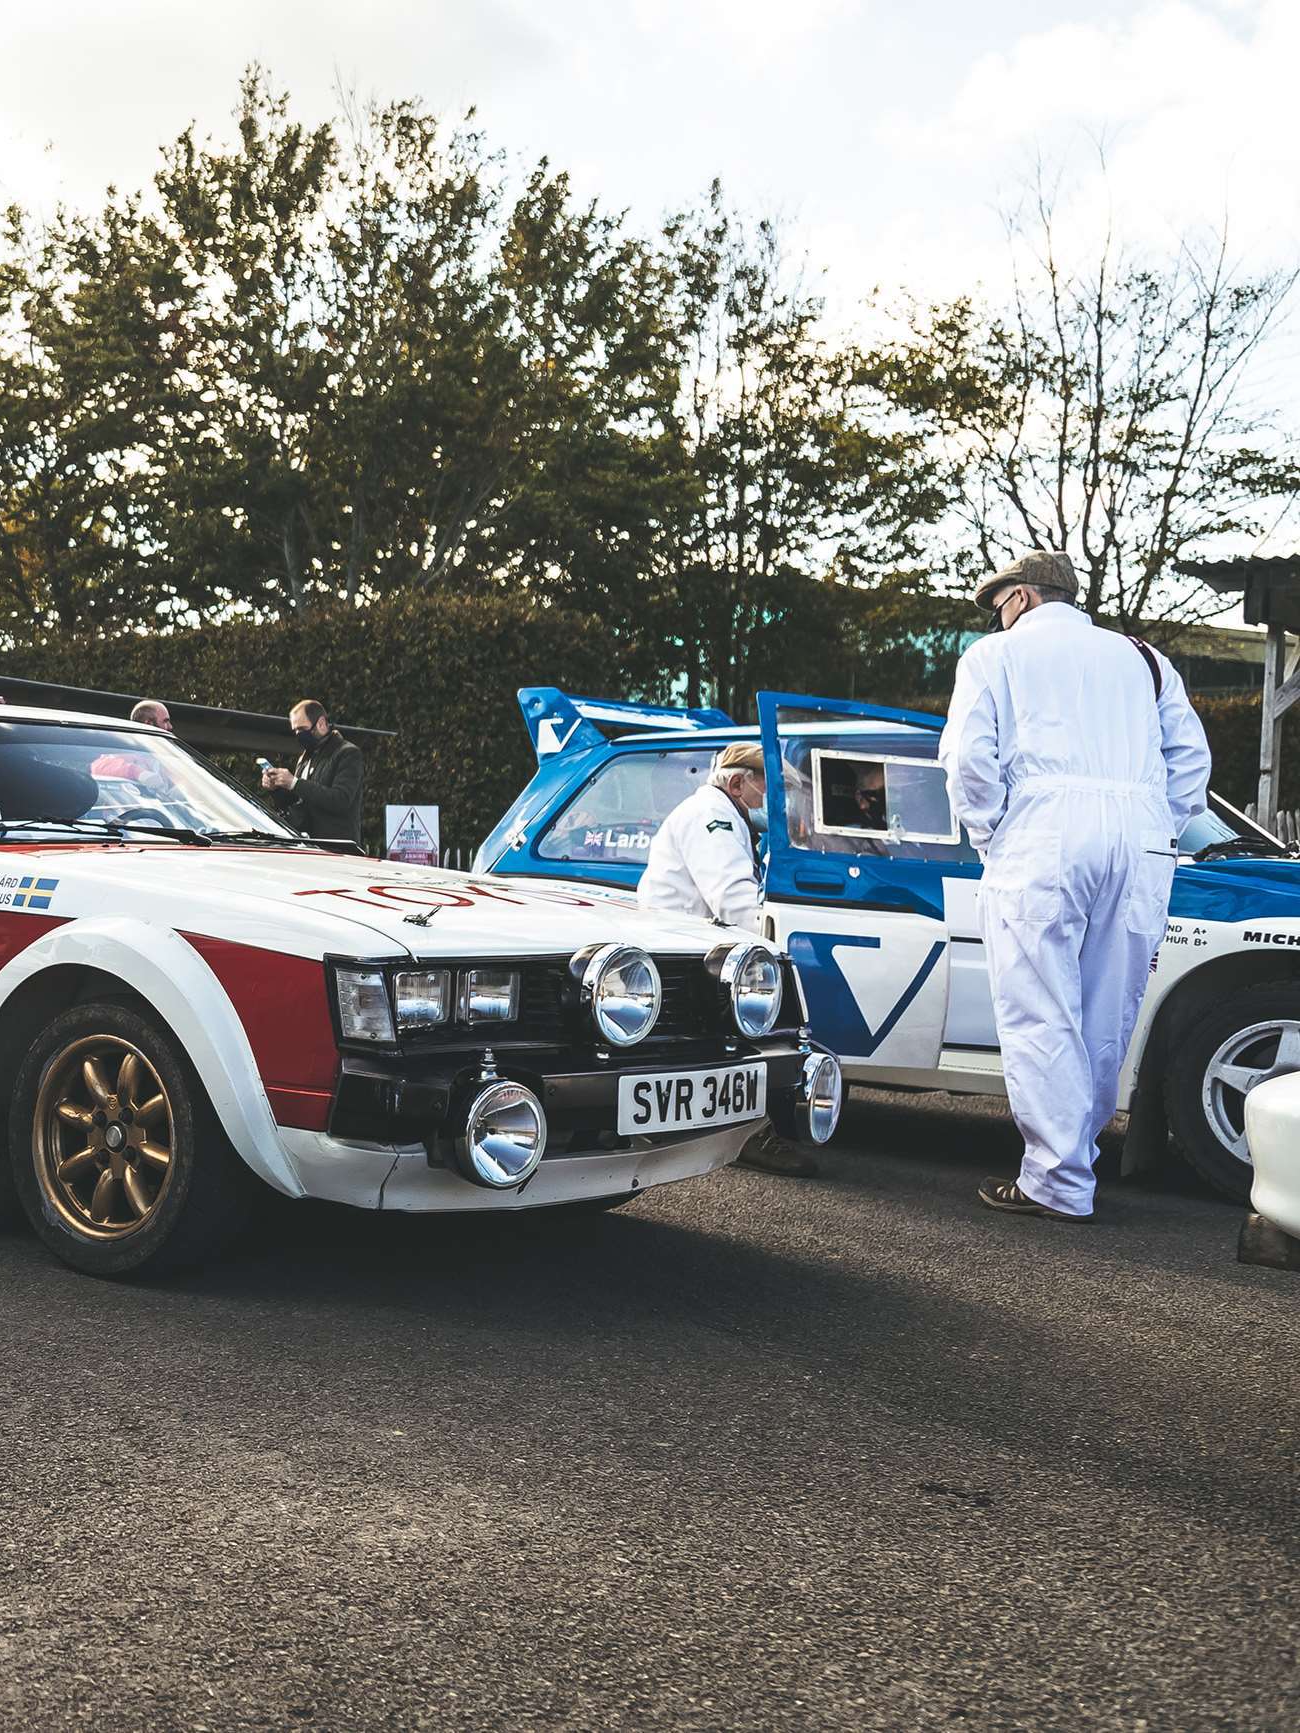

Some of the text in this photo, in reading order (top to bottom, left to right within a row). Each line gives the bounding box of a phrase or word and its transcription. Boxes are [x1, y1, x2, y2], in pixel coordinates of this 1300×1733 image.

[605, 829, 650, 848] Larb
[292, 886, 637, 911] TOYO
[1166, 924, 1207, 935] ND A+
[1242, 930, 1300, 946] MICH
[1194, 938, 1208, 947] B+
[632, 1069, 758, 1125] SVR 346W
